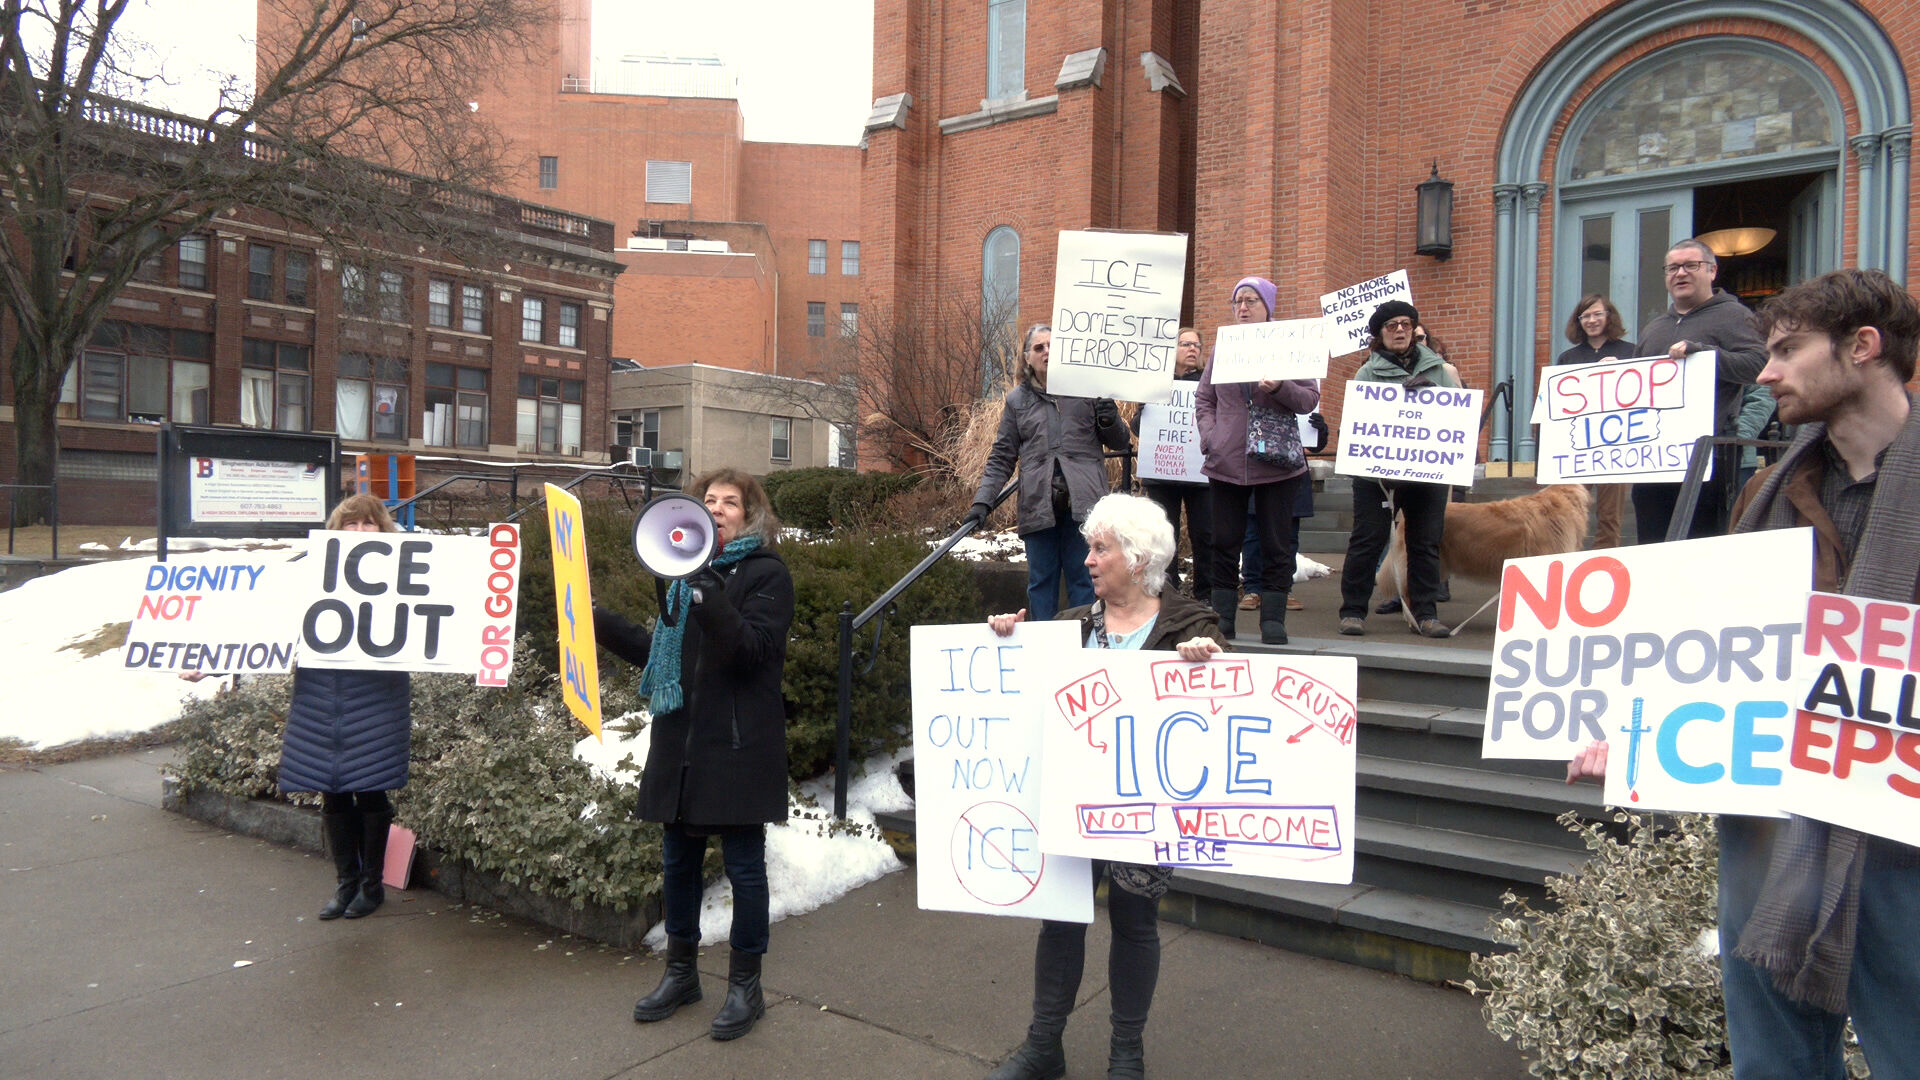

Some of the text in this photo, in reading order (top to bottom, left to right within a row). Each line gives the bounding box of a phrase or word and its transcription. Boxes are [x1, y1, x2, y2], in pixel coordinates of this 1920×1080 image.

[1078, 259, 1152, 289] ICE
[1337, 275, 1390, 300] NO MORE
[1322, 280, 1406, 316] ICE/DETENTION
[1058, 308, 1177, 340] DOMESTIC
[1336, 310, 1365, 326] PASS
[1055, 337, 1175, 372] TERRORIST
[1403, 388, 1472, 408] ROOM
[1556, 358, 1679, 415] STOP
[1168, 410, 1194, 427] ICE!
[1352, 421, 1465, 444] HATRED OR
[1398, 409, 1423, 420] FOR
[1584, 408, 1650, 449] ICE
[1155, 444, 1184, 454] NOEM
[1158, 428, 1193, 443] FIRE:
[196, 458, 214, 478] B
[1154, 453, 1184, 461] BOVINO
[1154, 460, 1185, 468] HOMAN
[1154, 467, 1187, 476] MILLER
[1403, 468, 1444, 480] Francis
[554, 507, 573, 562] NY
[145, 564, 266, 592] DIGNITY
[322, 537, 433, 597] ICE
[136, 595, 203, 621] NOT
[478, 523, 519, 686] FOR GOOD
[1498, 555, 1631, 633] NO
[302, 598, 455, 660] OUT
[564, 583, 576, 643] 4
[1803, 594, 1920, 673] RE
[124, 641, 292, 671] DETENTION
[940, 645, 1023, 695] ICE
[1494, 623, 1801, 689] SUPPORT
[565, 646, 592, 712] ALL
[1164, 664, 1245, 694] MELT
[1803, 662, 1920, 730] ALL
[1065, 680, 1110, 717] NO
[1276, 675, 1353, 745] CRUSH
[1490, 688, 1609, 743] FOR
[928, 714, 1010, 750] OUT
[1115, 711, 1272, 801] ICE
[951, 756, 1030, 794] NOW
[1085, 808, 1331, 847] NOT WELCOME
[967, 825, 1037, 874] ICE
[1154, 840, 1229, 862] HERE
